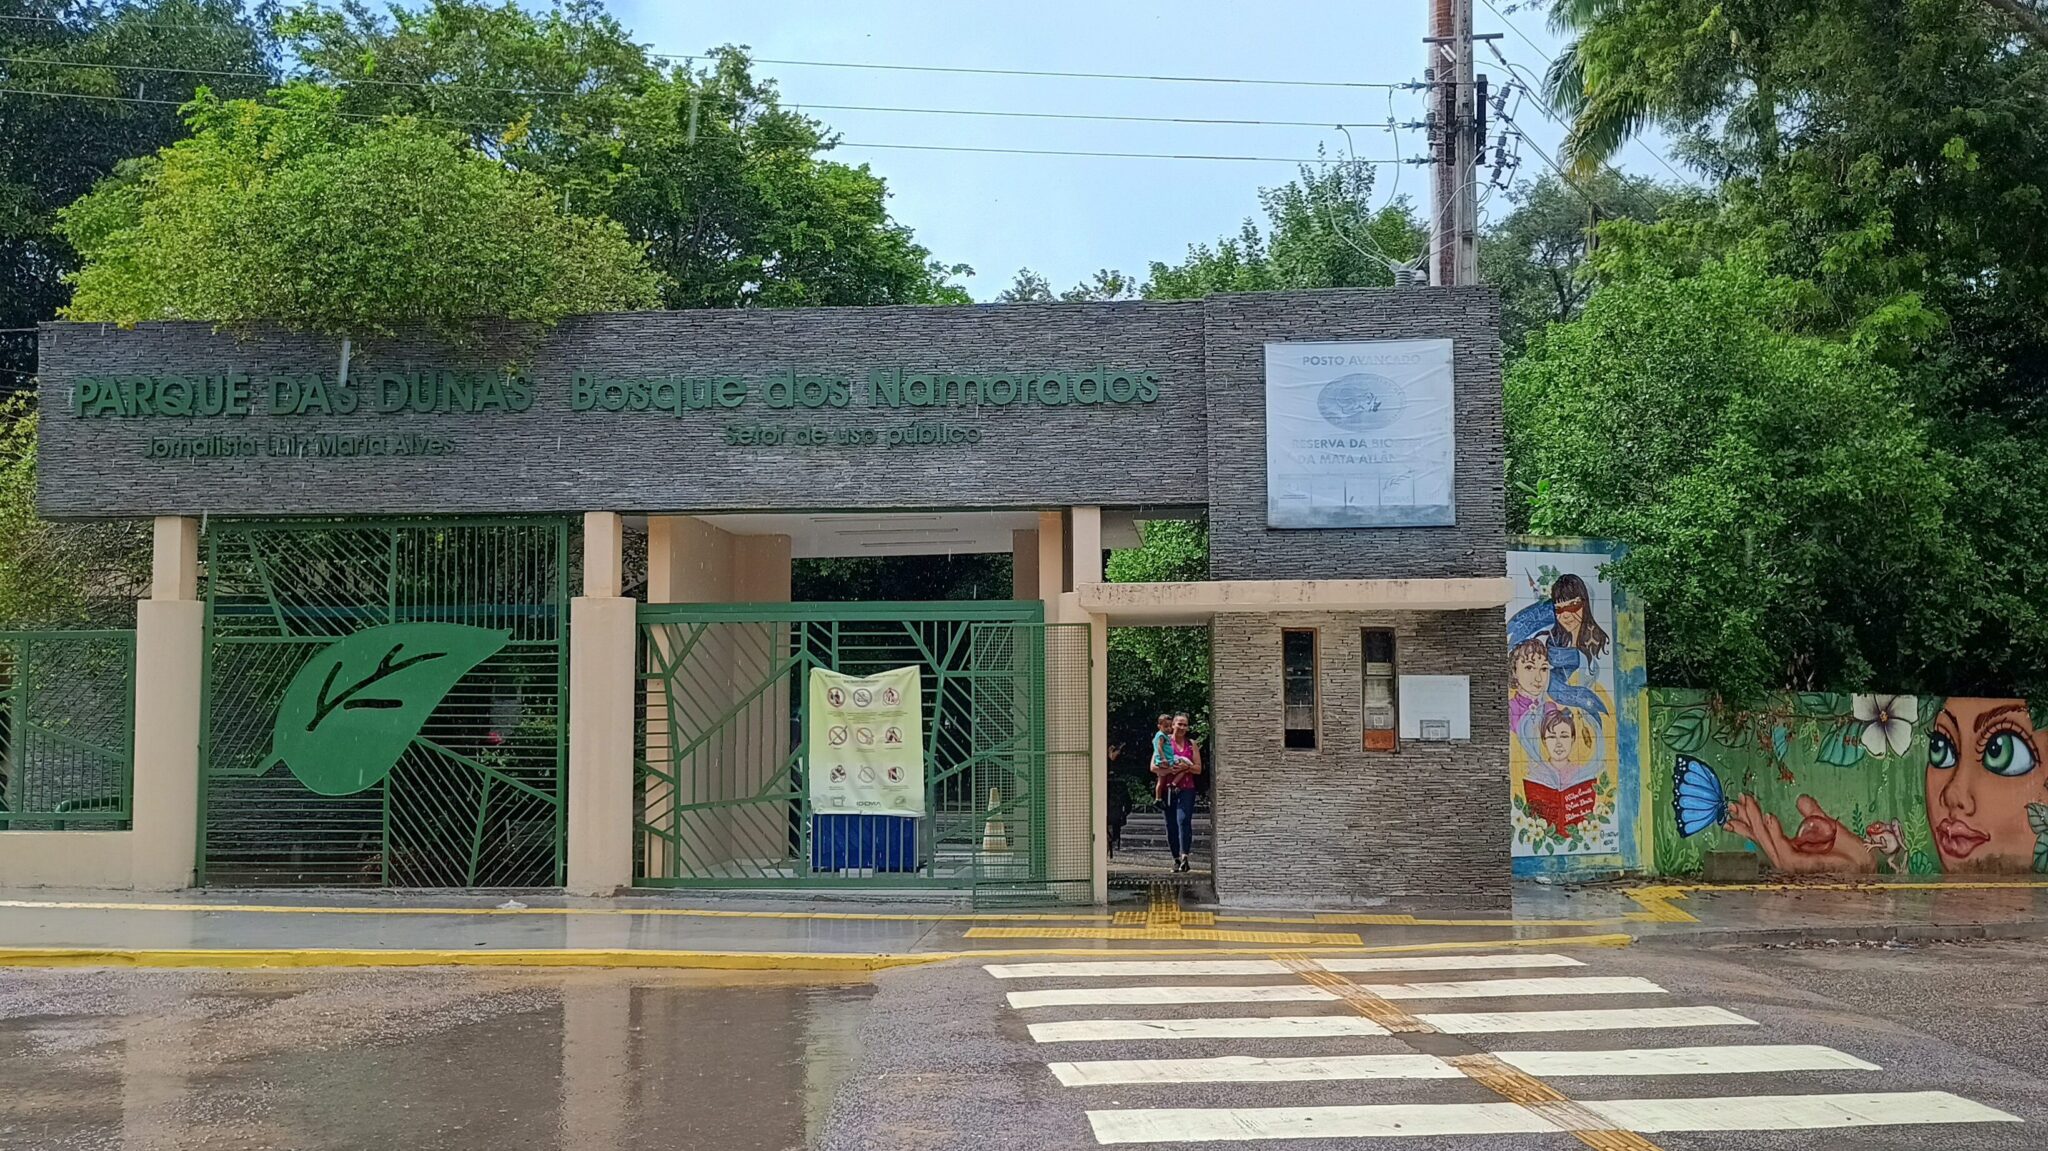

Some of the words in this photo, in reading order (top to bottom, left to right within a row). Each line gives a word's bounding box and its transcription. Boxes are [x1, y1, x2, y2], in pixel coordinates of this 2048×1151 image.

[1302, 356, 1345, 366] POSTO
[74, 374, 250, 416] PARQUE
[267, 374, 360, 415] DAS
[374, 370, 534, 413] DUNAS
[571, 369, 748, 418] Bosque
[763, 368, 851, 408] dos
[867, 364, 1160, 408] Namorados
[144, 435, 257, 458] Jornalista
[393, 433, 456, 455] Alves
[726, 425, 786, 446] Setor
[796, 426, 828, 445] de
[837, 427, 877, 445] uso
[887, 420, 983, 449] público
[1349, 438, 1368, 449] DA
